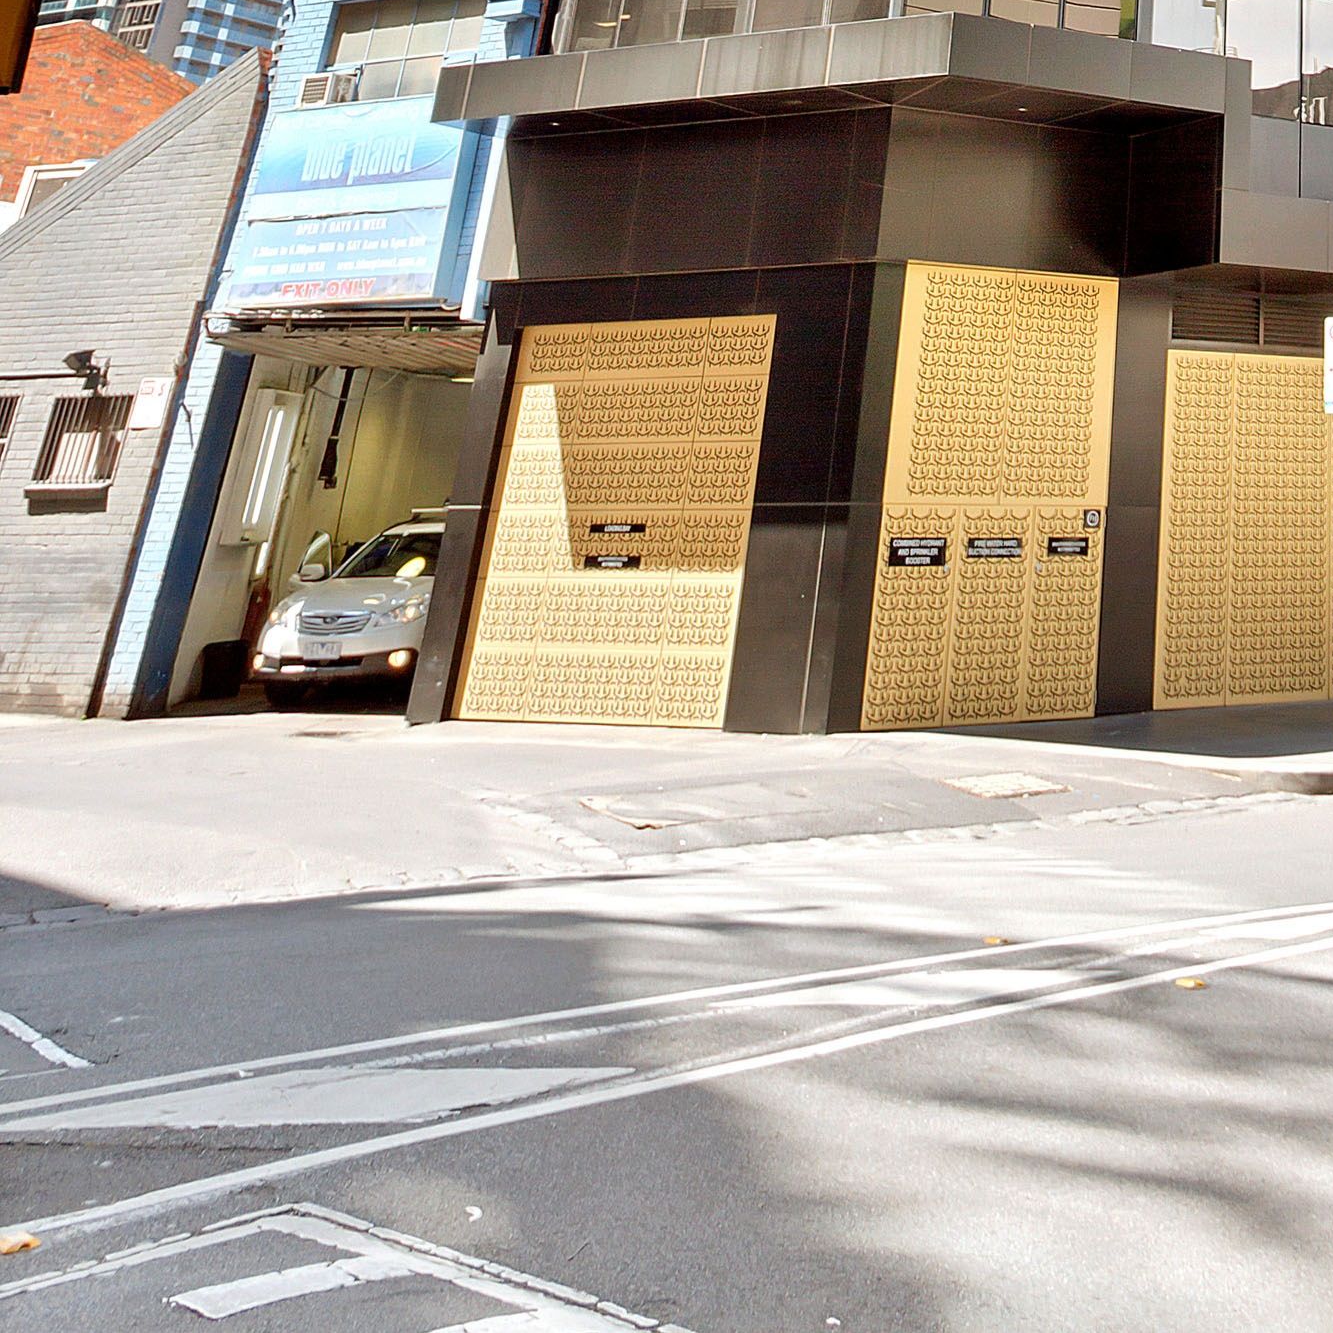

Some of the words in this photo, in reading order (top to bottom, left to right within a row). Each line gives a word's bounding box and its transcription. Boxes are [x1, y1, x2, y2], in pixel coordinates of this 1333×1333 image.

[346, 130, 416, 186] planet
[295, 222, 320, 236] OPEN
[328, 220, 352, 233] DAYS
[353, 219, 361, 231] A
[361, 218, 388, 231] WEEK
[280, 281, 320, 298] EXIT
[326, 277, 377, 297] ONLY
